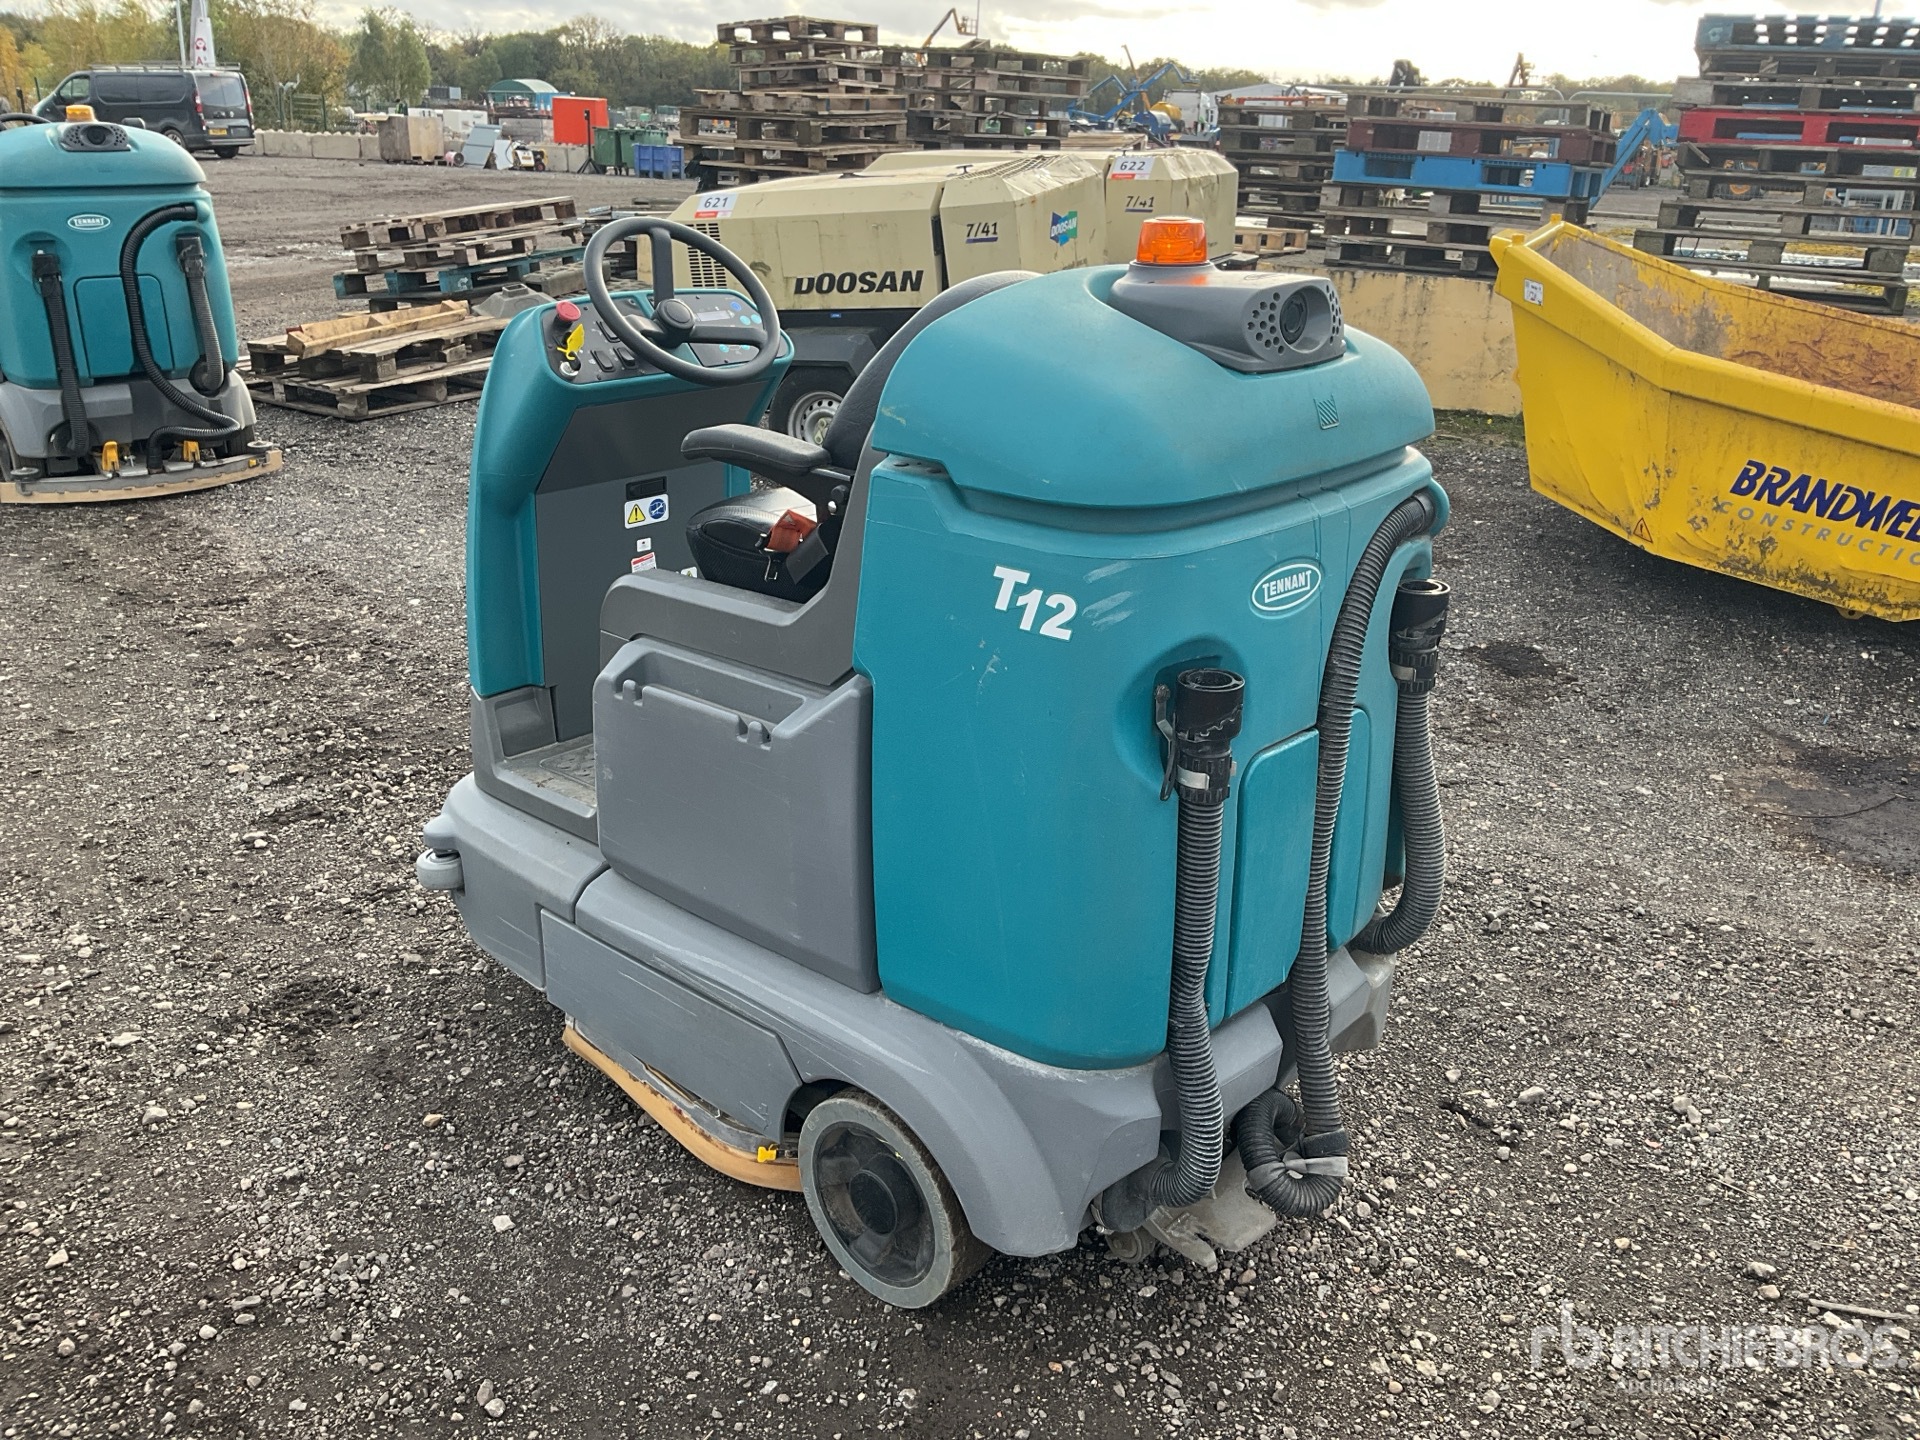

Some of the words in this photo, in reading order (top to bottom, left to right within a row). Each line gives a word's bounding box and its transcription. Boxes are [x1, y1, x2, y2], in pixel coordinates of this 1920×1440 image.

[1120, 161, 1146, 171] 622
[704, 197, 729, 208] 621
[1125, 195, 1155, 208] 7/41
[966, 221, 998, 238] 7/41
[1050, 216, 1078, 238] DOOSAN
[793, 269, 925, 295] DOOSAN
[1262, 570, 1312, 604] TENNANT
[993, 565, 1077, 641] T12
